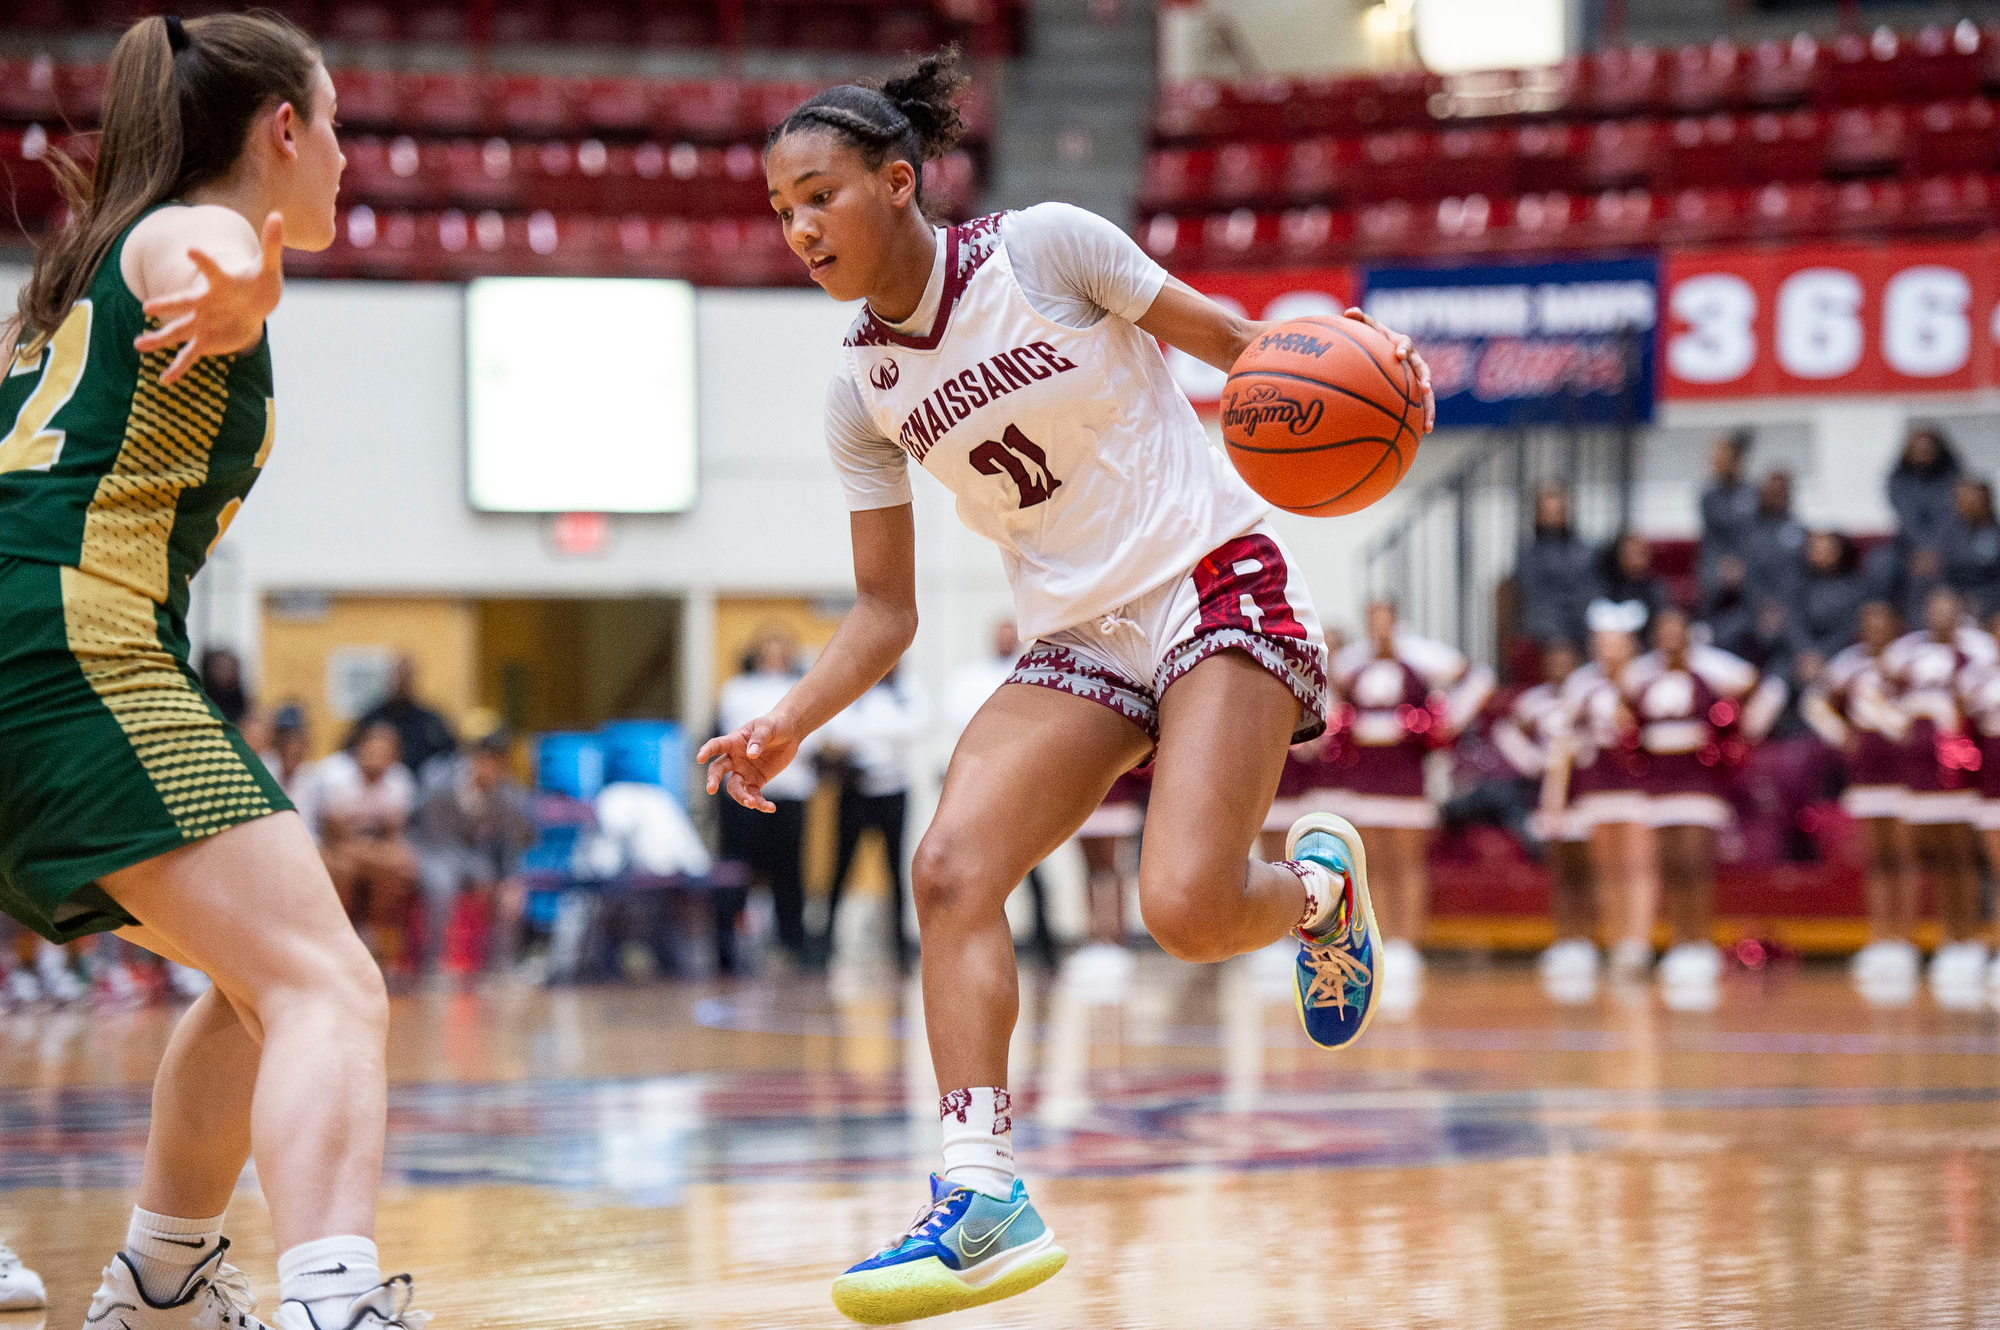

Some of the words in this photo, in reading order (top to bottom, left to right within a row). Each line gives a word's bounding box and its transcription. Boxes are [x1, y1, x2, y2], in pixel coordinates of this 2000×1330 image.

[1667, 264, 2000, 385] 366
[969, 422, 1062, 509] 21
[1193, 533, 1308, 641] R
